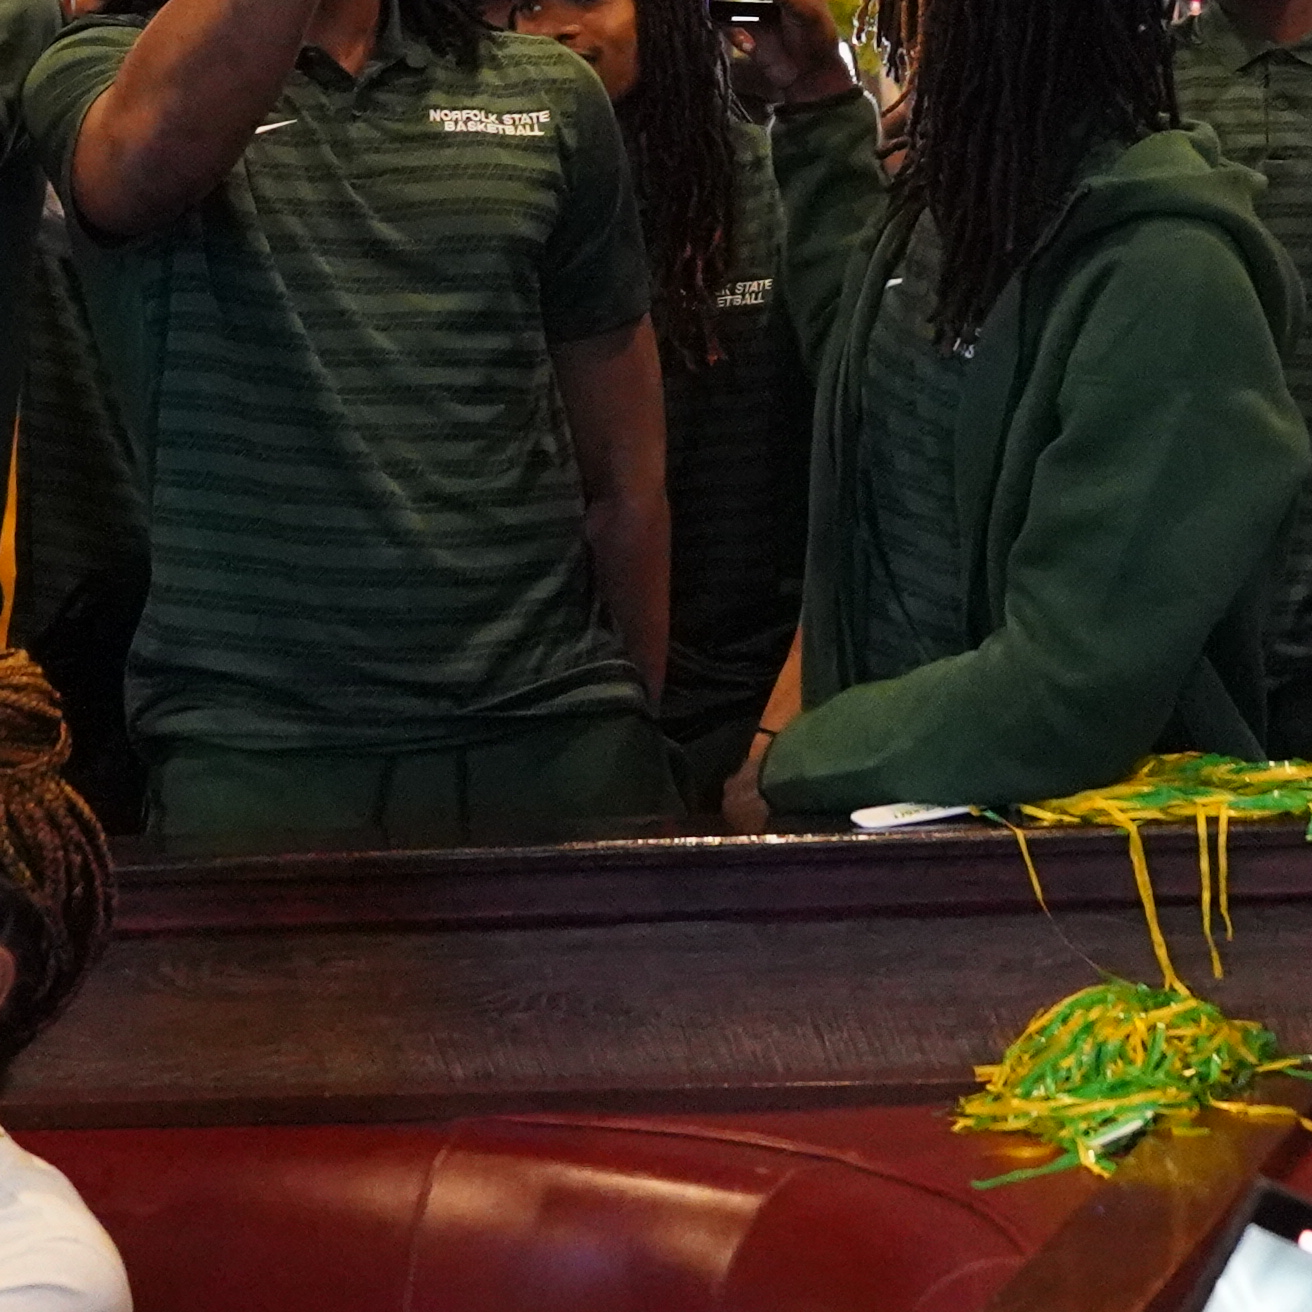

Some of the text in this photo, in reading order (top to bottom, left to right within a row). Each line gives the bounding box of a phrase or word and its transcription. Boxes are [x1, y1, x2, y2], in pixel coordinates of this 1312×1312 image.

[429, 109, 550, 125] NORFOLK STATE
[444, 121, 545, 136] BASKETBALL
[735, 279, 773, 294] STATE
[716, 292, 765, 308] ETBALL
